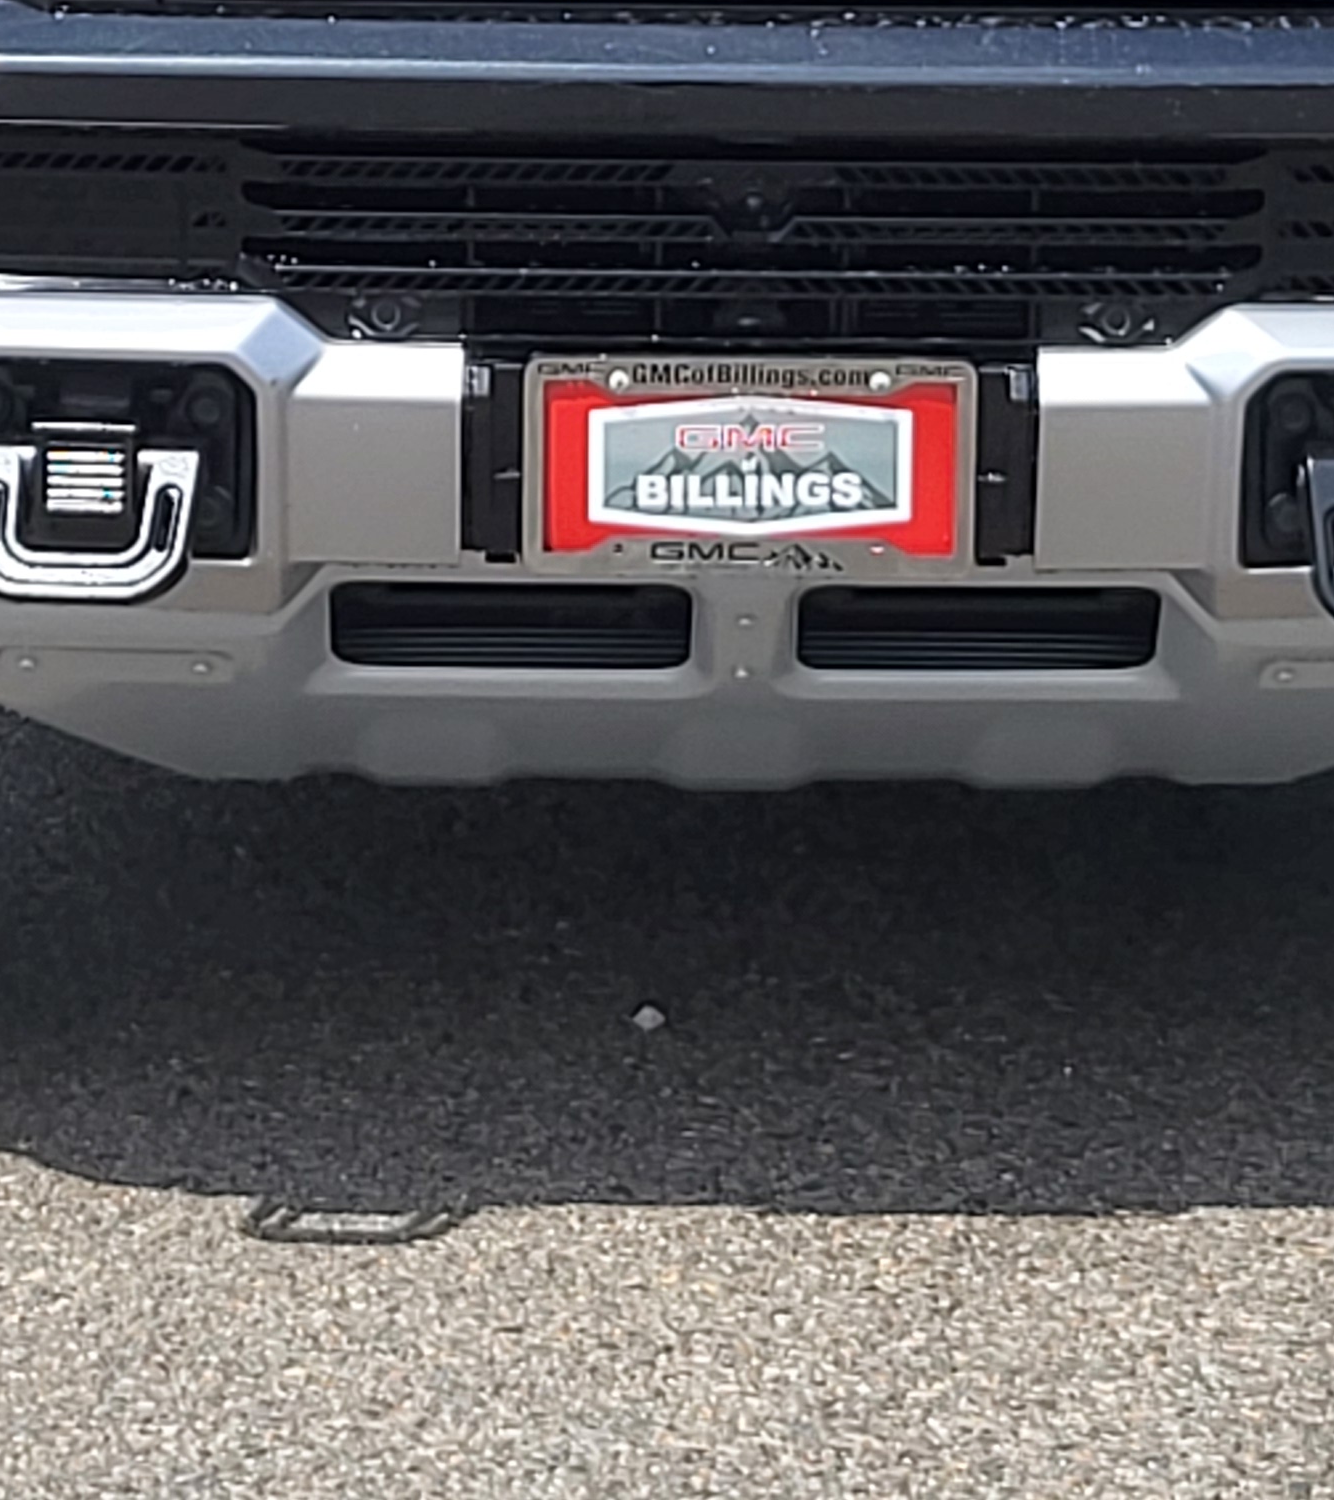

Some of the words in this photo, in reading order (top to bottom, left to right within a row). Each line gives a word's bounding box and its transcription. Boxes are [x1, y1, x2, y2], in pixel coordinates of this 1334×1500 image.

[632, 362, 870, 389] GMCofBillings.com
[675, 423, 825, 451] GMC
[636, 471, 863, 509] BILLINGS
[650, 542, 760, 562] GMC
